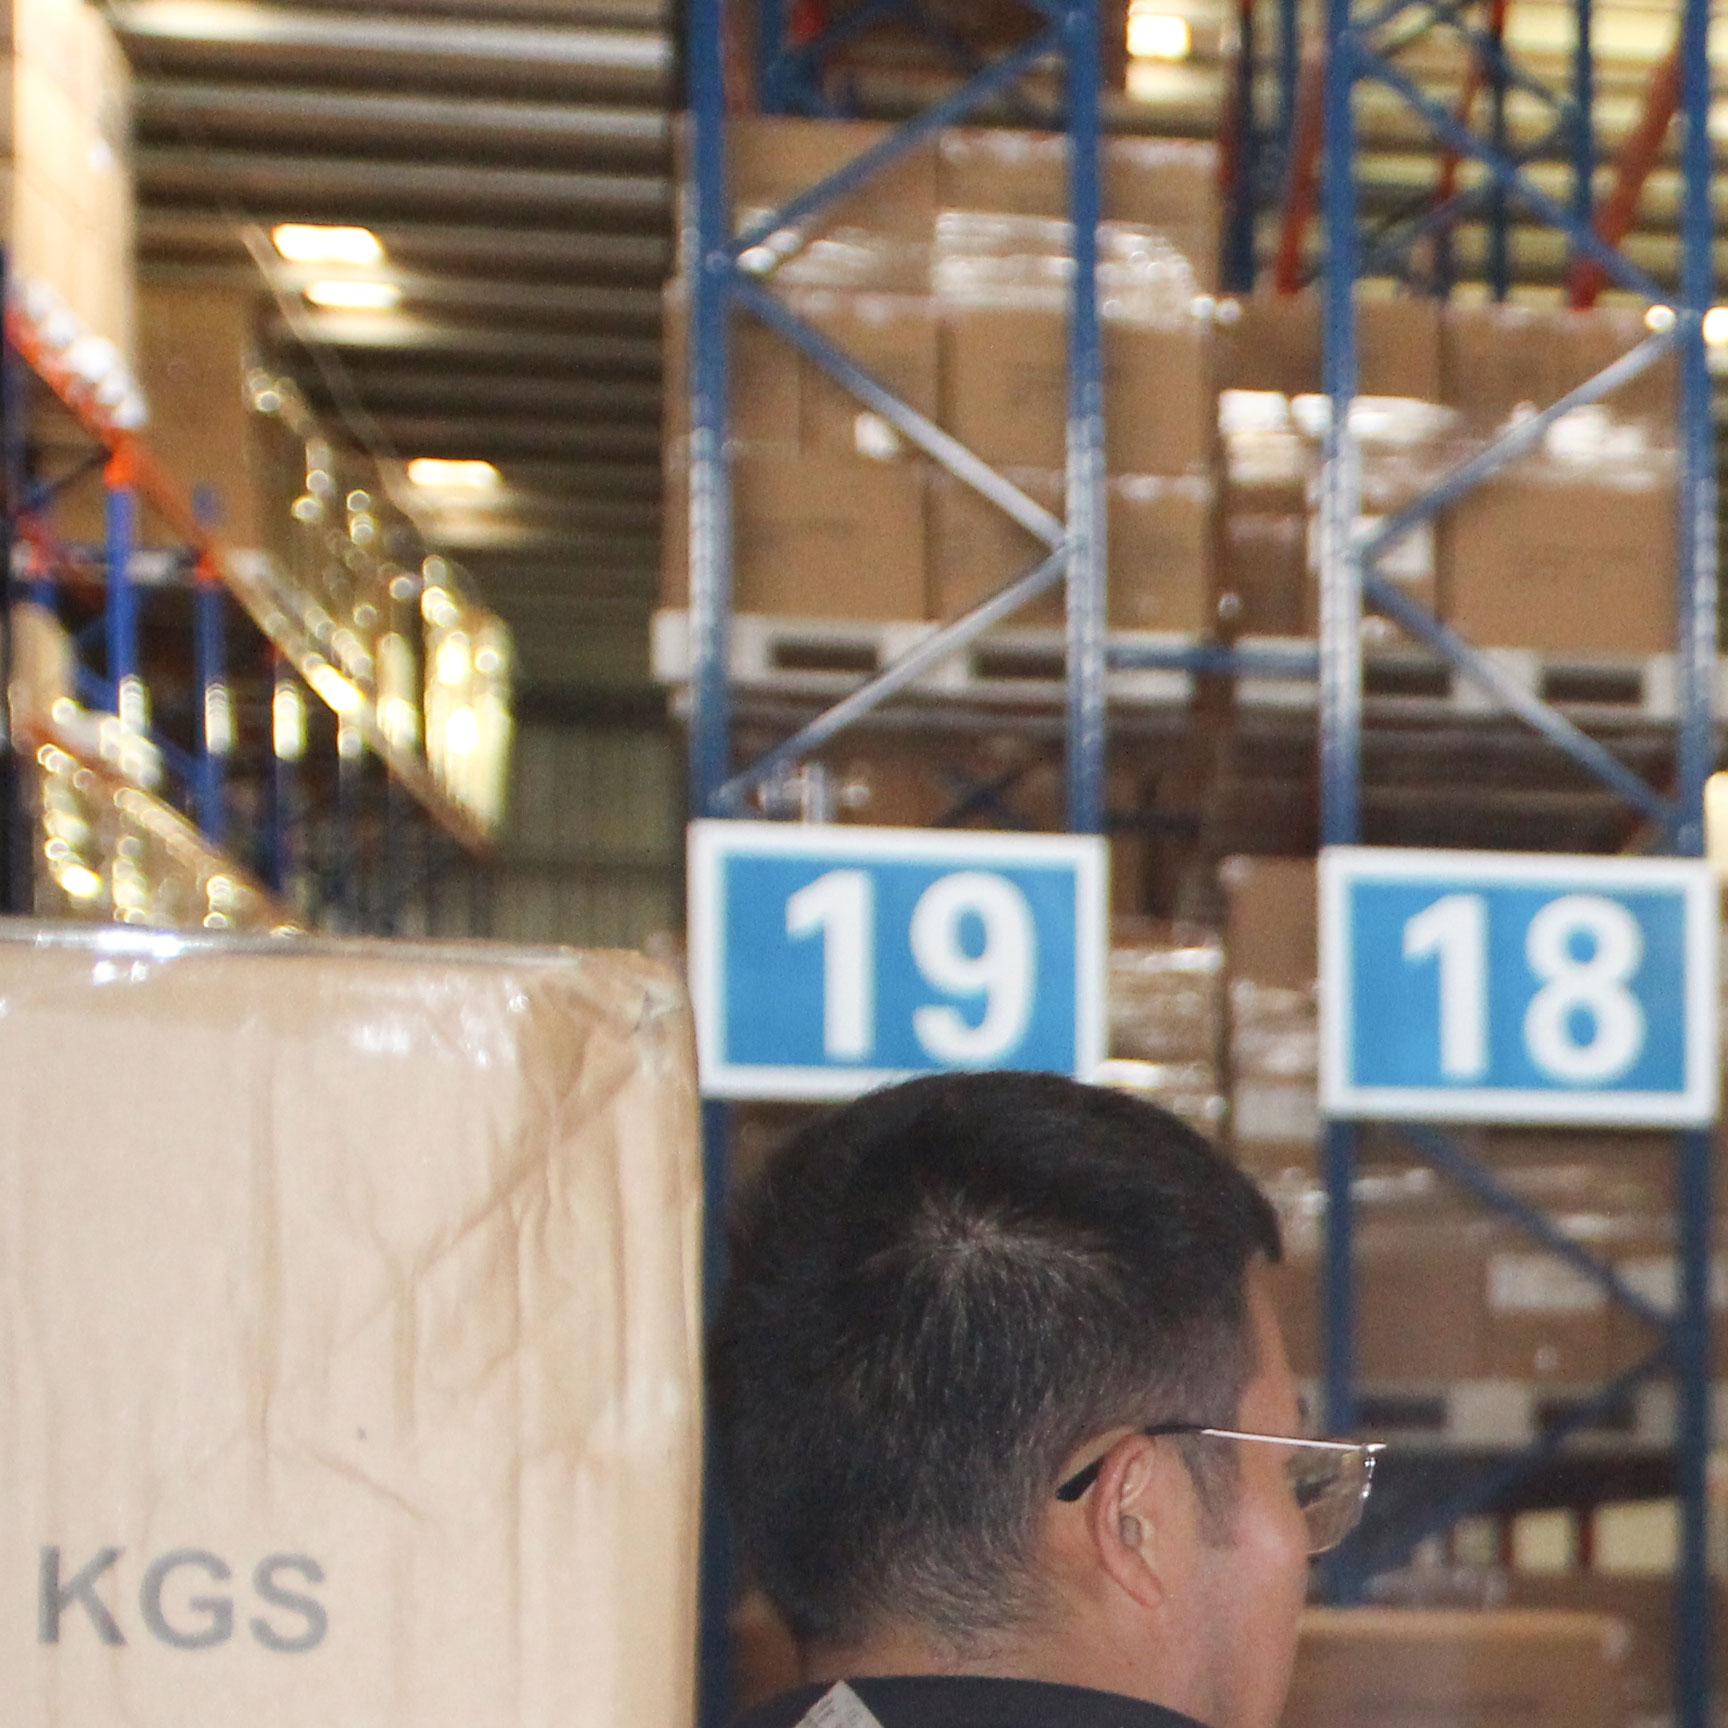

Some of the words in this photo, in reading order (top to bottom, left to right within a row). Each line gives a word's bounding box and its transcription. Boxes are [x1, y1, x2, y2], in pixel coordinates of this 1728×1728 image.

[785, 869, 1036, 1064] 19
[1403, 892, 1645, 1082] 18
[36, 1545, 330, 1654] KGS
